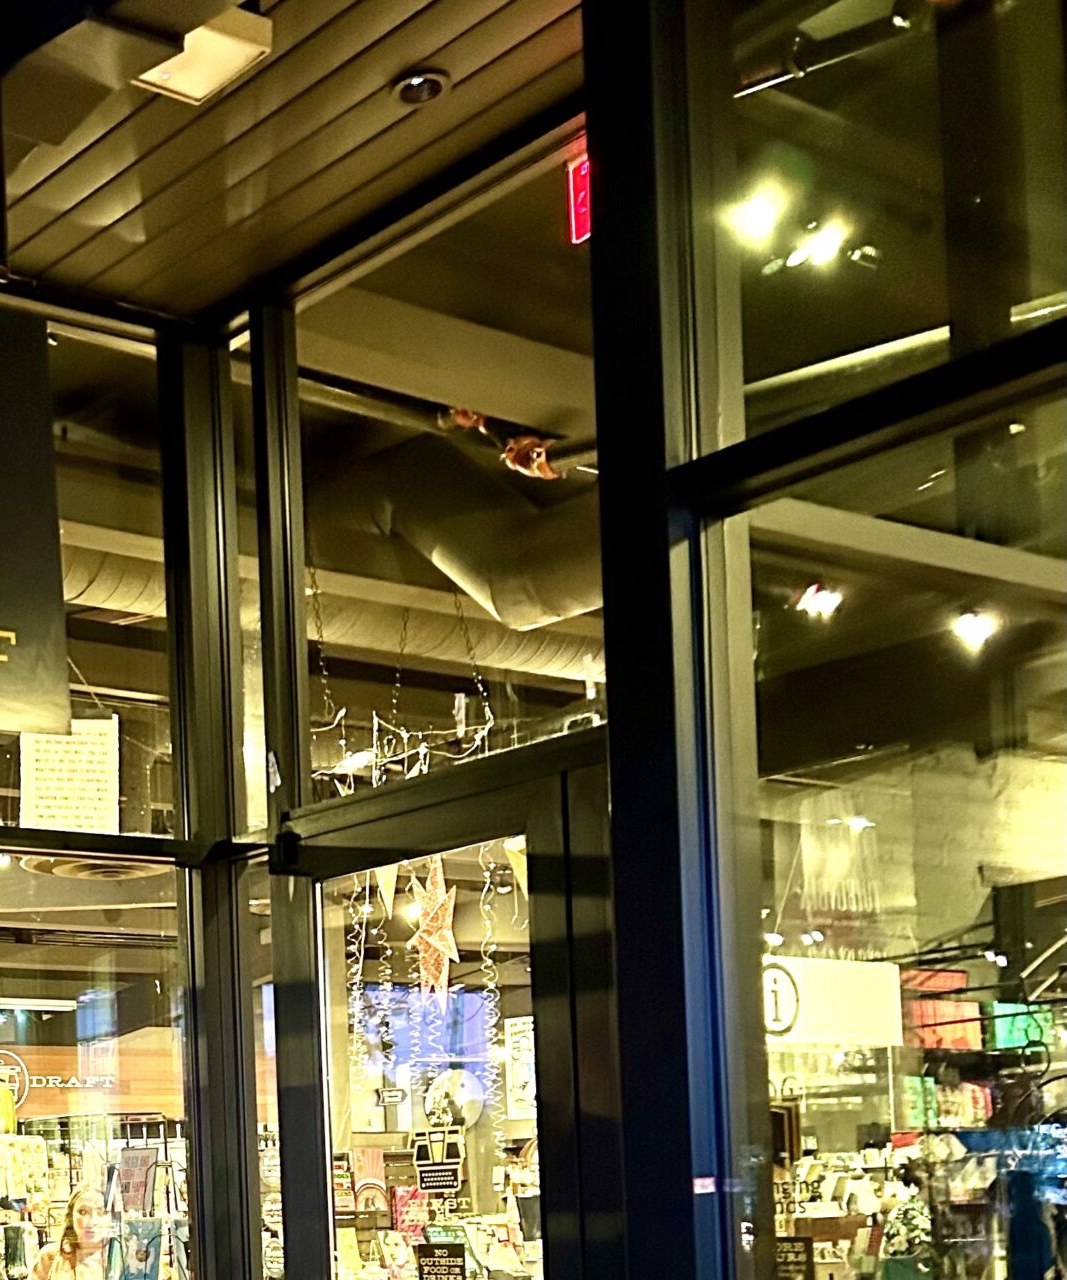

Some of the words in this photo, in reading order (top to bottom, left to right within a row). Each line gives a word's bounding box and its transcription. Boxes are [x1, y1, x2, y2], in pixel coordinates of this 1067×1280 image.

[29, 1075, 114, 1089] DRAFT
[773, 1179, 821, 1200] nging
[433, 1249, 449, 1258] NO
[420, 1258, 464, 1266] OUTSIDE
[423, 1266, 449, 1274] FOOD
